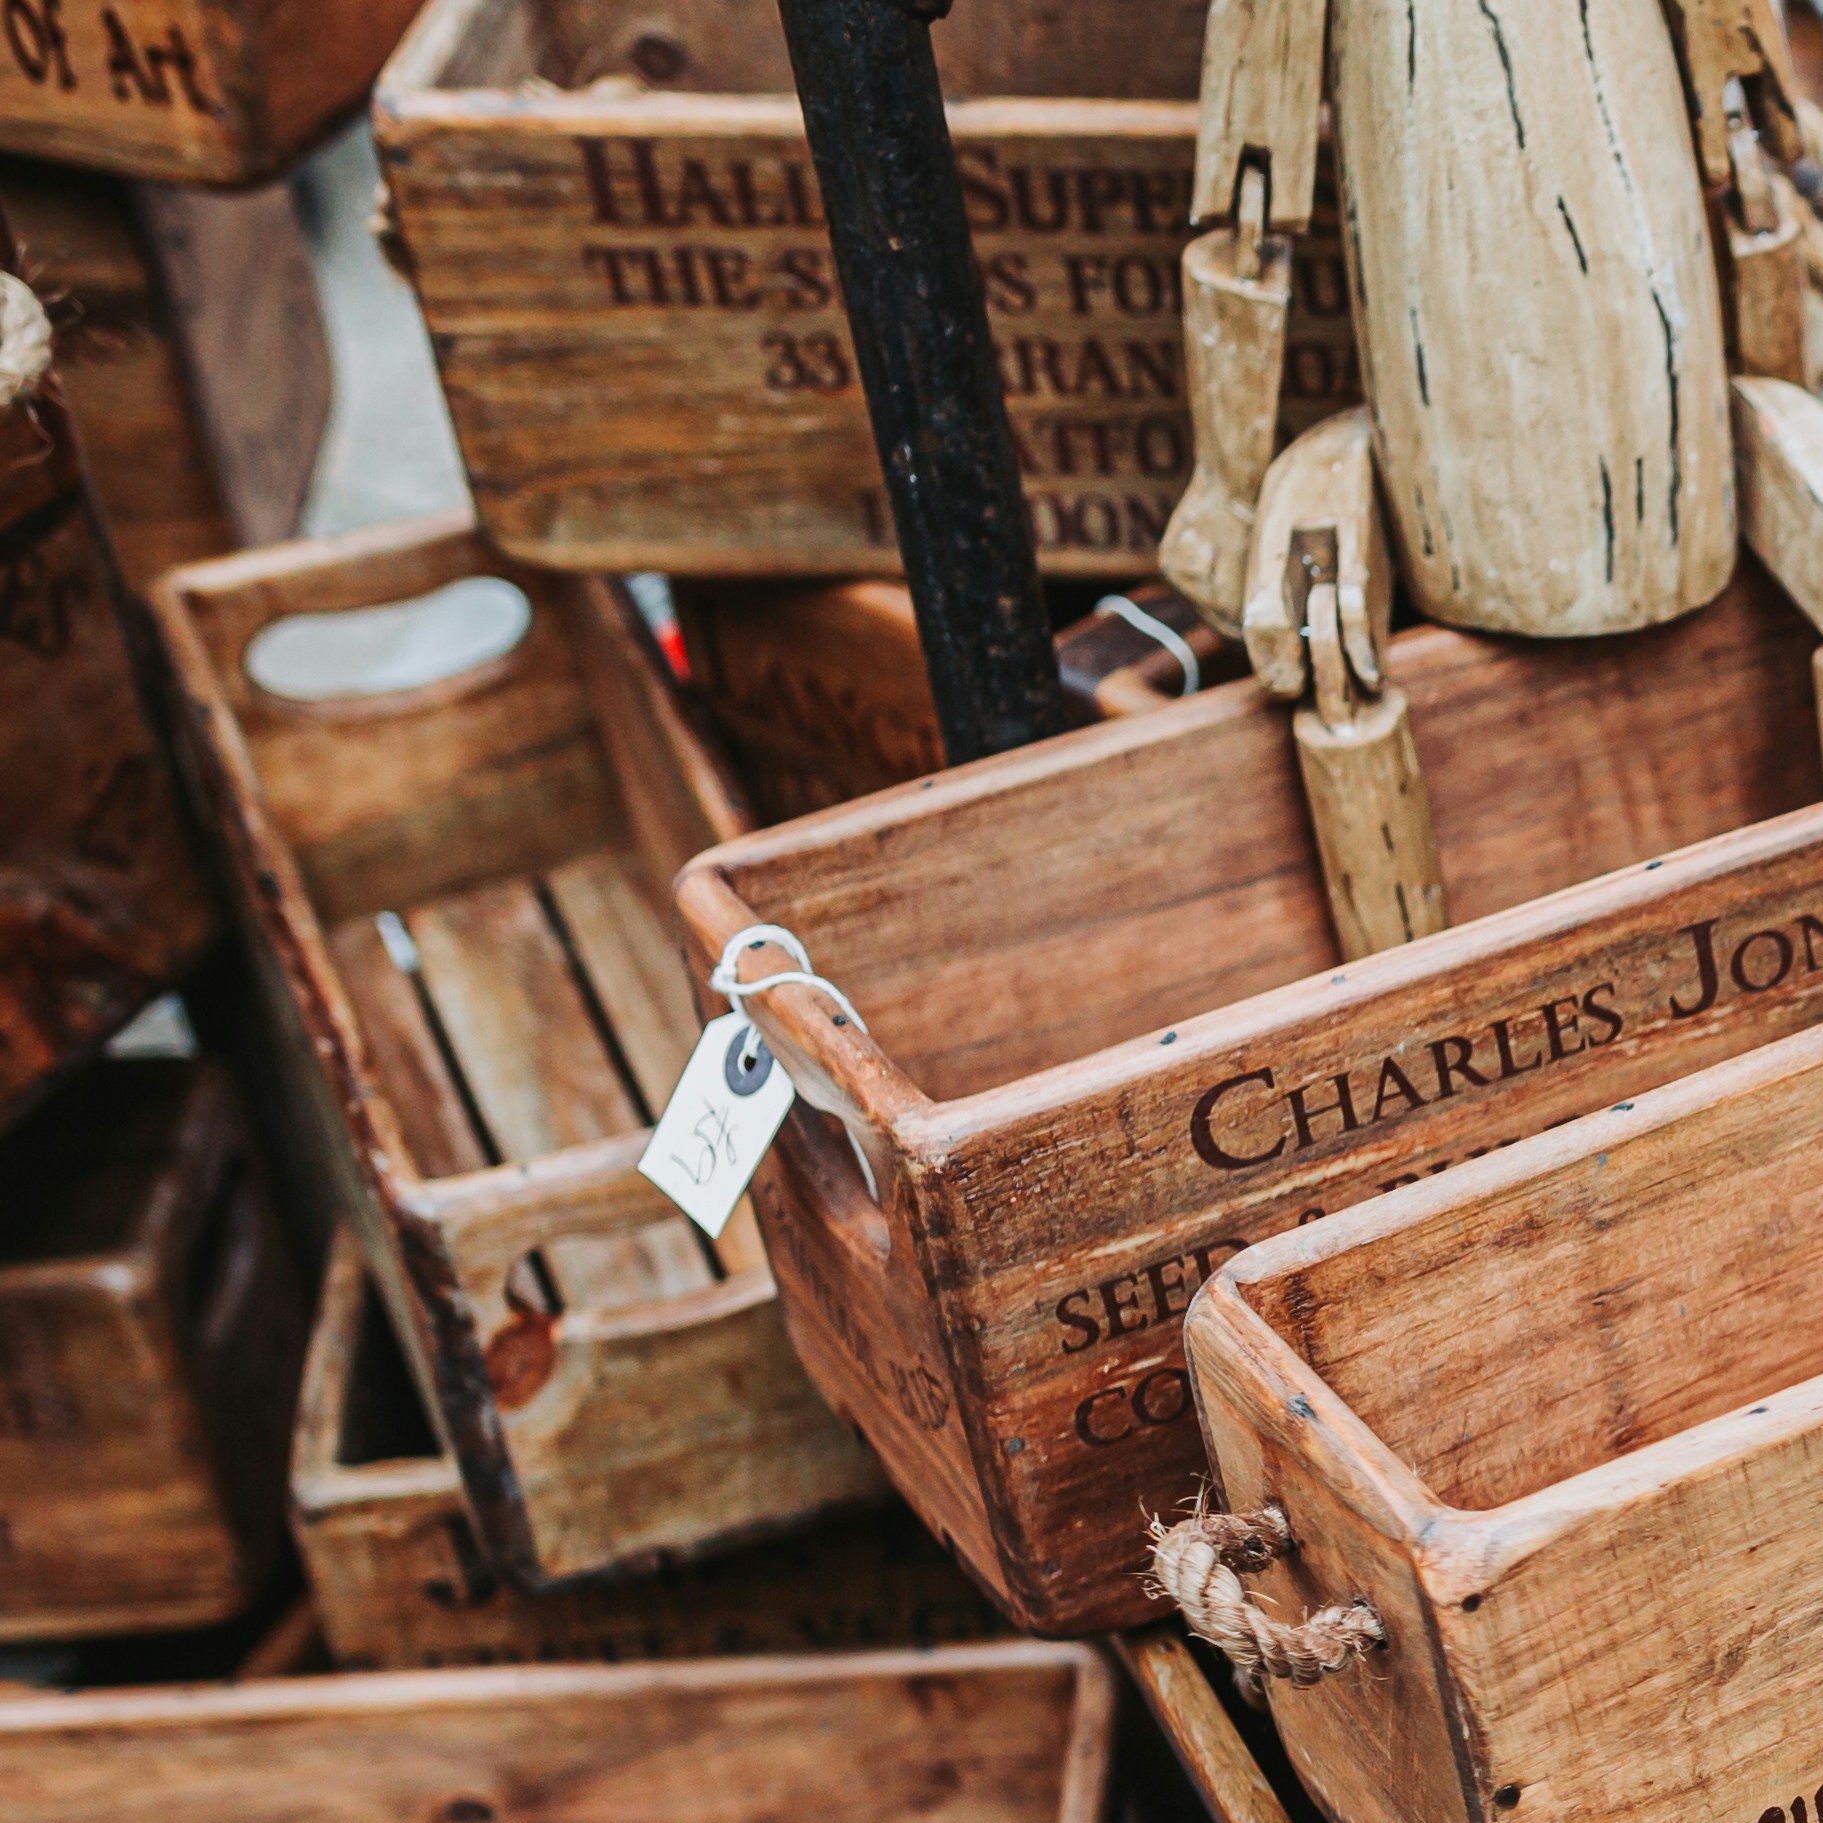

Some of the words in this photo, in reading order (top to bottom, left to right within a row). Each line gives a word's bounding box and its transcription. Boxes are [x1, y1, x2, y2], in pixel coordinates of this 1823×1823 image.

[582, 245, 758, 310] THE
[1064, 254, 1186, 317] FO
[1187, 984, 1625, 1171] CHARLES
